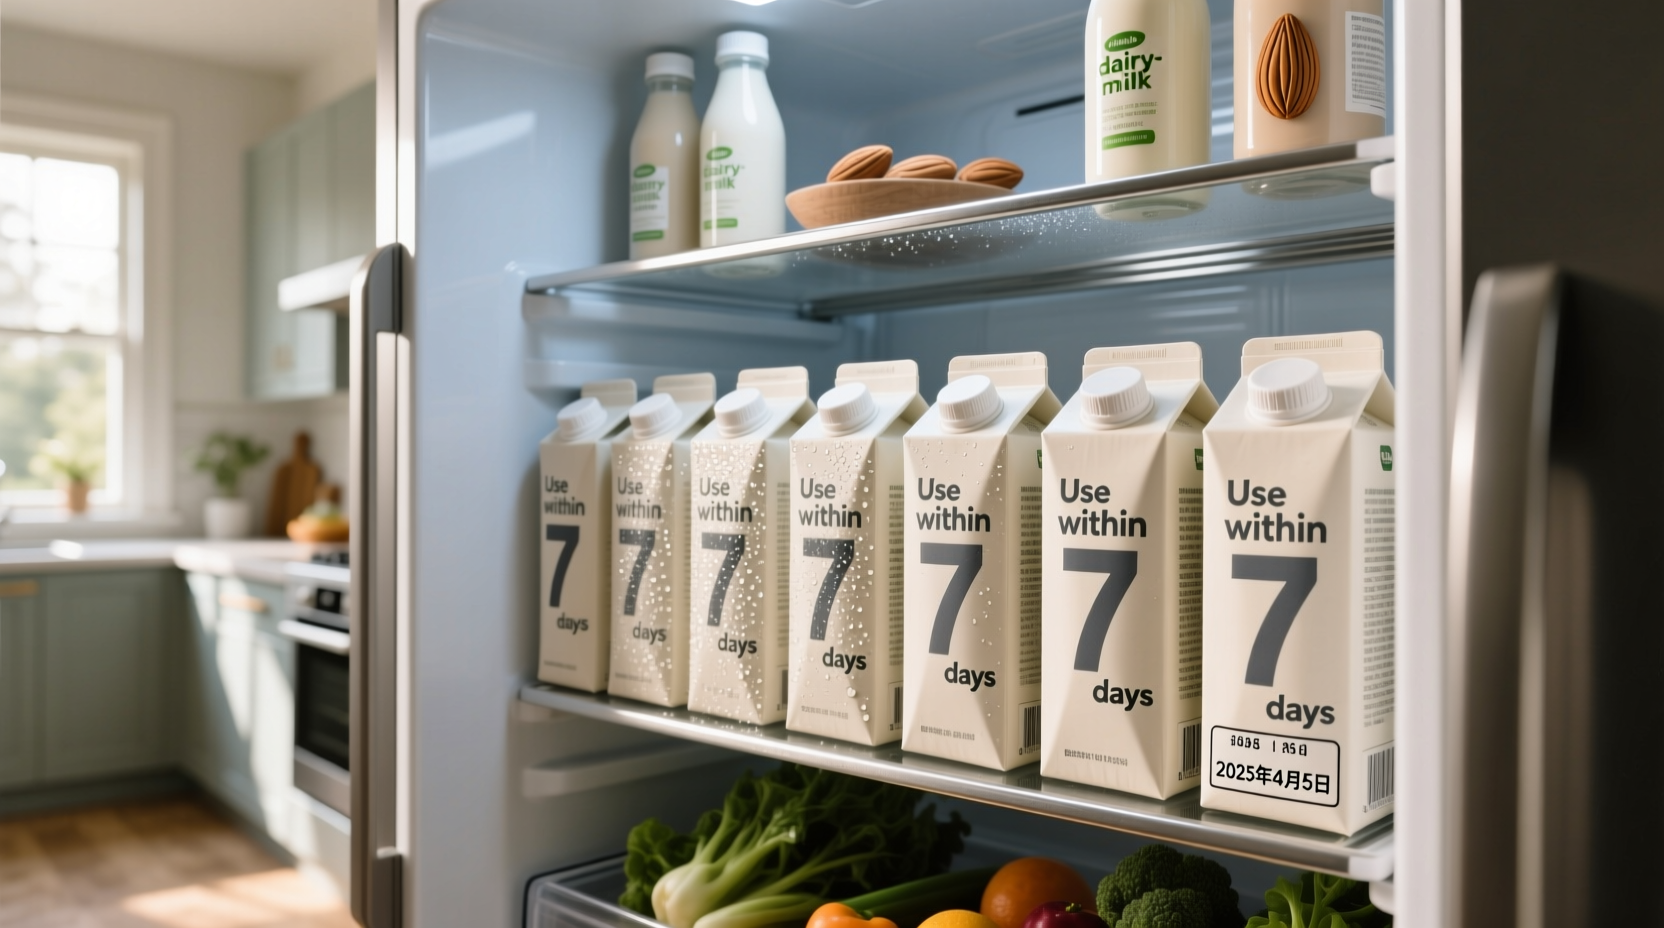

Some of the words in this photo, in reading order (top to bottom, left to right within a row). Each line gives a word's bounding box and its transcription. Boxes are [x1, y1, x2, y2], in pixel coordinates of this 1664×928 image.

[1099, 51, 1162, 76] dairy-
[1103, 71, 1152, 95] milk
[545, 475, 569, 494] Use
[617, 476, 643, 496] Use
[699, 477, 730, 497] Use
[800, 477, 836, 500] Use
[918, 477, 961, 501] Use
[1060, 478, 1111, 504] Use
[1227, 479, 1287, 507] Use
[544, 496, 586, 517] within
[616, 498, 662, 520] within
[697, 500, 754, 523] within
[798, 504, 863, 529] within
[916, 505, 992, 533] within
[1058, 509, 1148, 538] within
[1224, 512, 1328, 544] within
[546, 524, 580, 608] 7
[619, 528, 656, 616] 7
[702, 532, 746, 627] 7
[803, 537, 855, 642] 7
[920, 542, 984, 656] 7
[557, 613, 589, 635] days
[1063, 547, 1139, 673] 7
[1231, 553, 1318, 688] 7
[632, 622, 667, 645] days
[717, 633, 758, 659] days
[822, 646, 867, 674] days
[944, 662, 997, 693] days
[1092, 678, 1154, 712] days
[1265, 694, 1336, 730] days
[1215, 760, 1331, 796] 2025年4月5日
